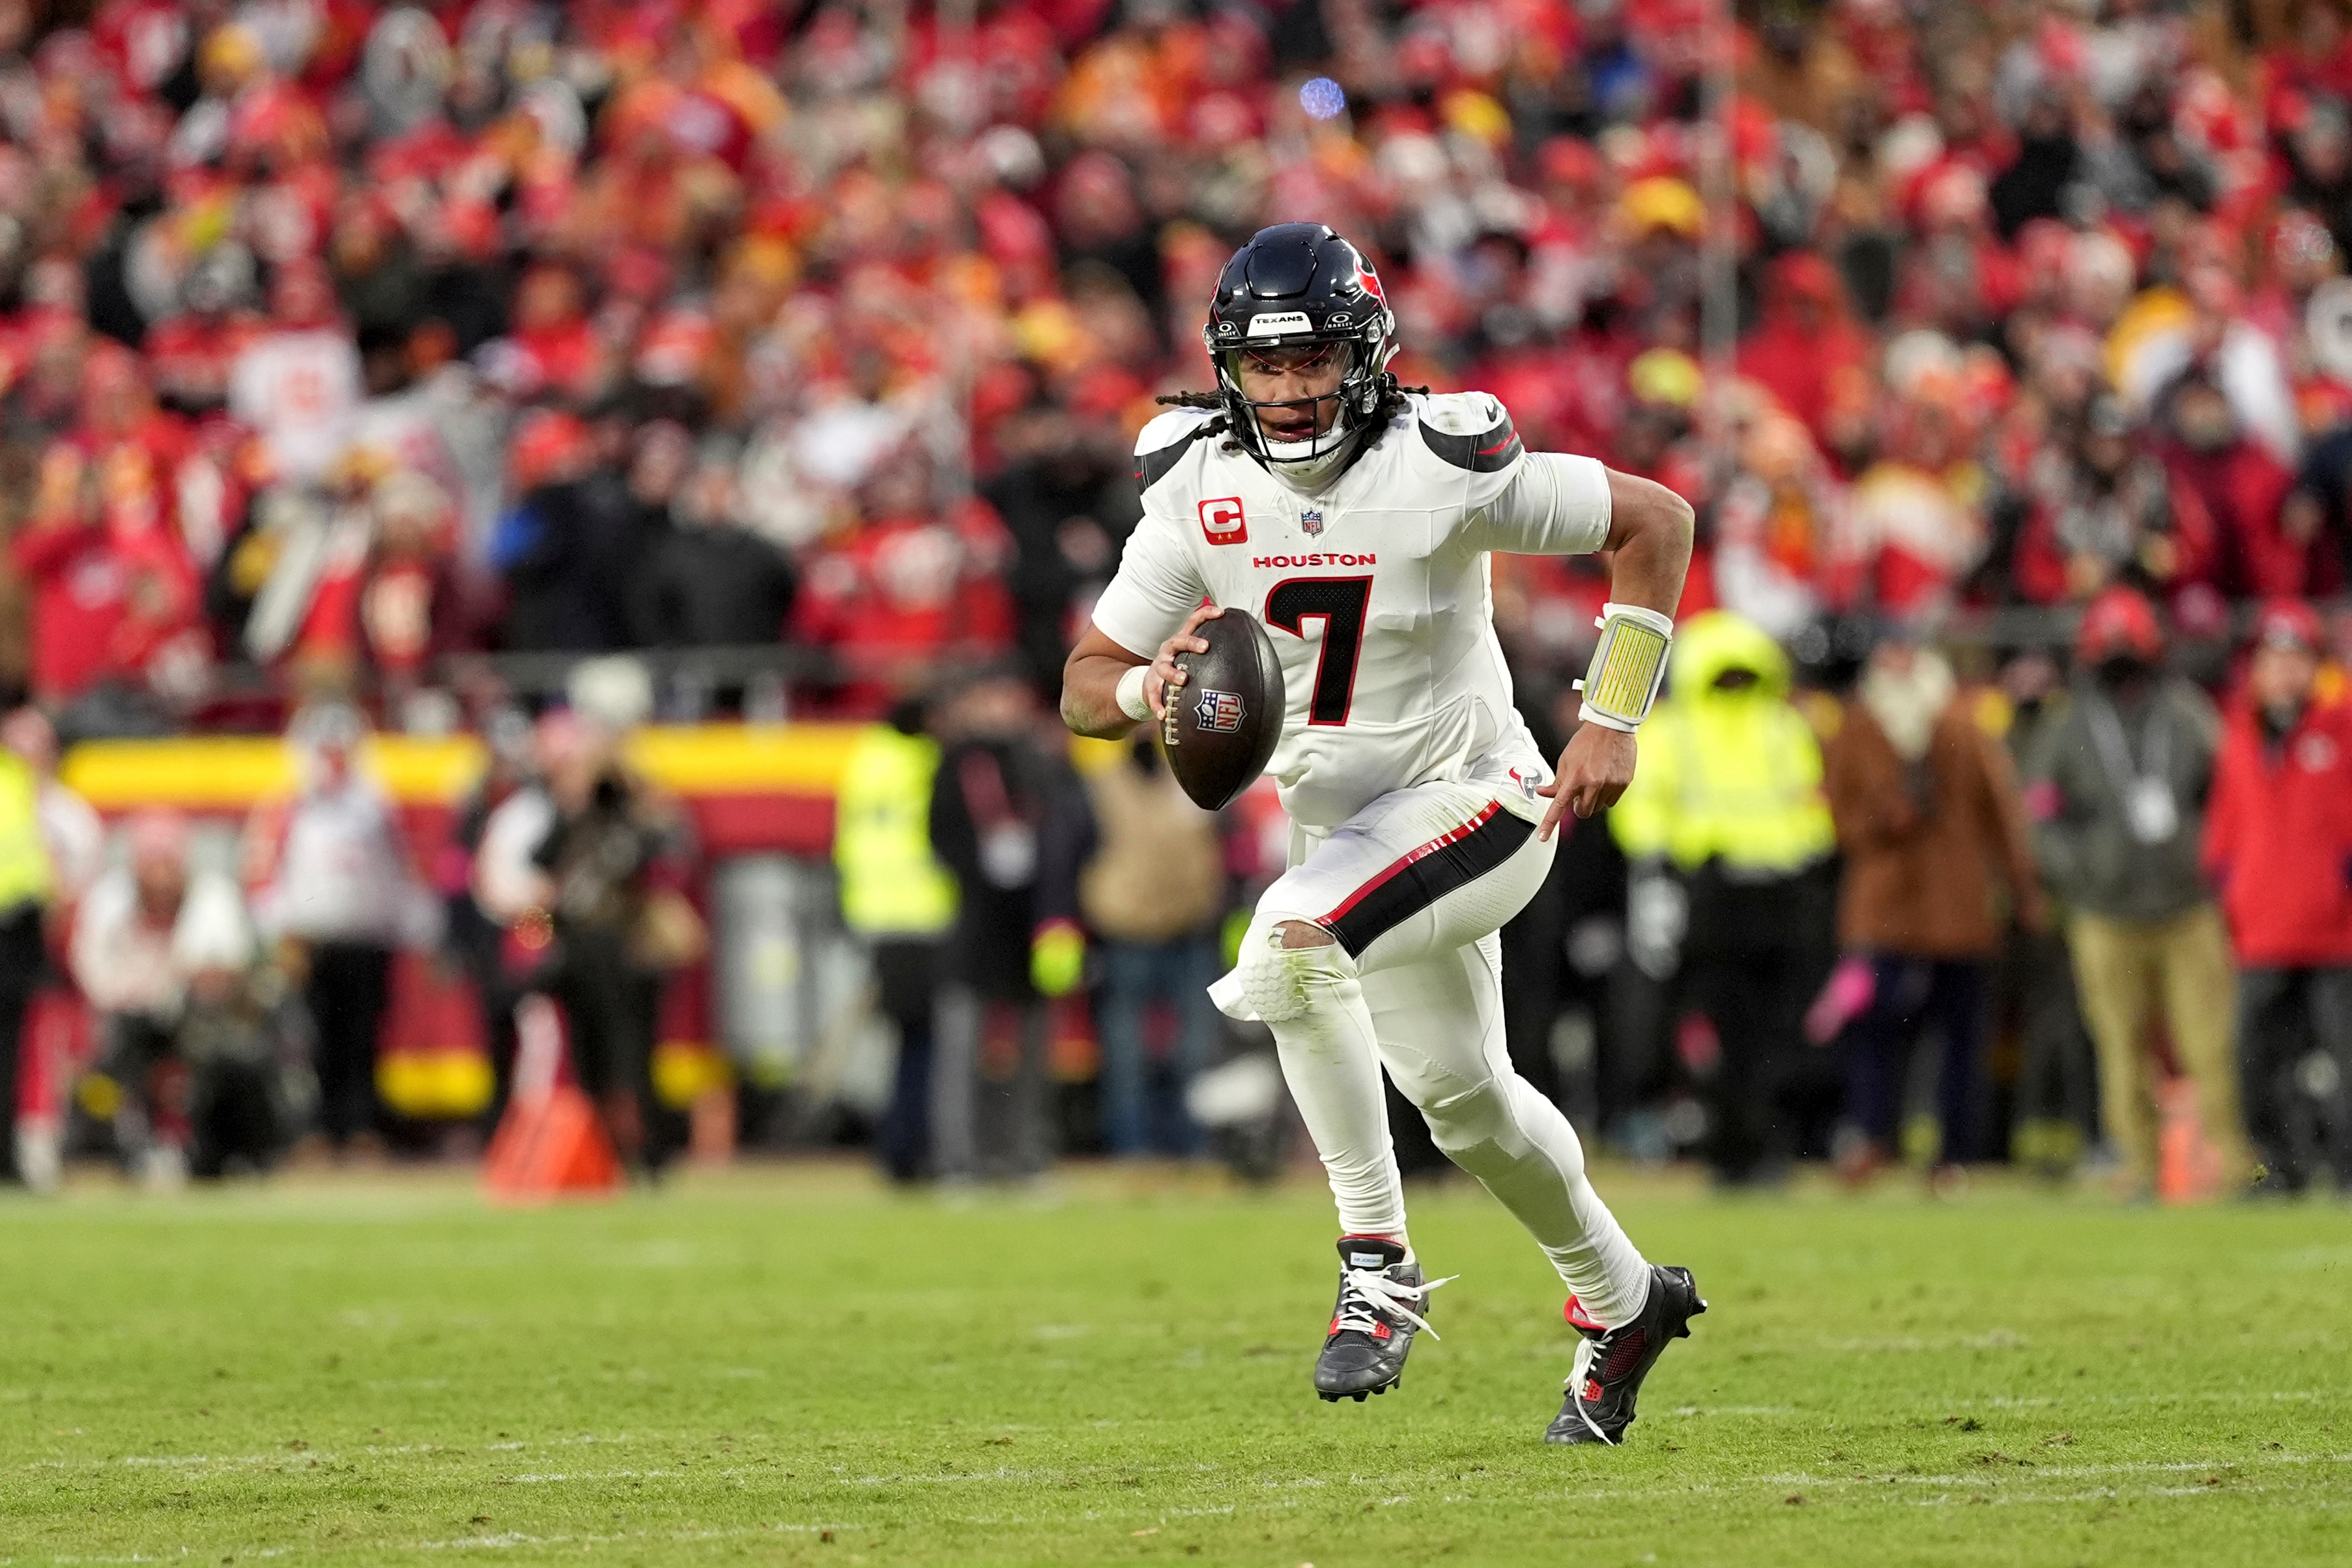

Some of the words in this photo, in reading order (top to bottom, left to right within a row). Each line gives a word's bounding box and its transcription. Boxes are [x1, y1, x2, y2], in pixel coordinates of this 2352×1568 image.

[1255, 315, 1304, 324] TEXANS
[1201, 500, 1242, 534] C
[1304, 521, 1321, 532] NFL
[1253, 553, 1377, 568] HOUSTON
[1264, 574, 1374, 727] 7
[1216, 697, 1241, 729] NFL
